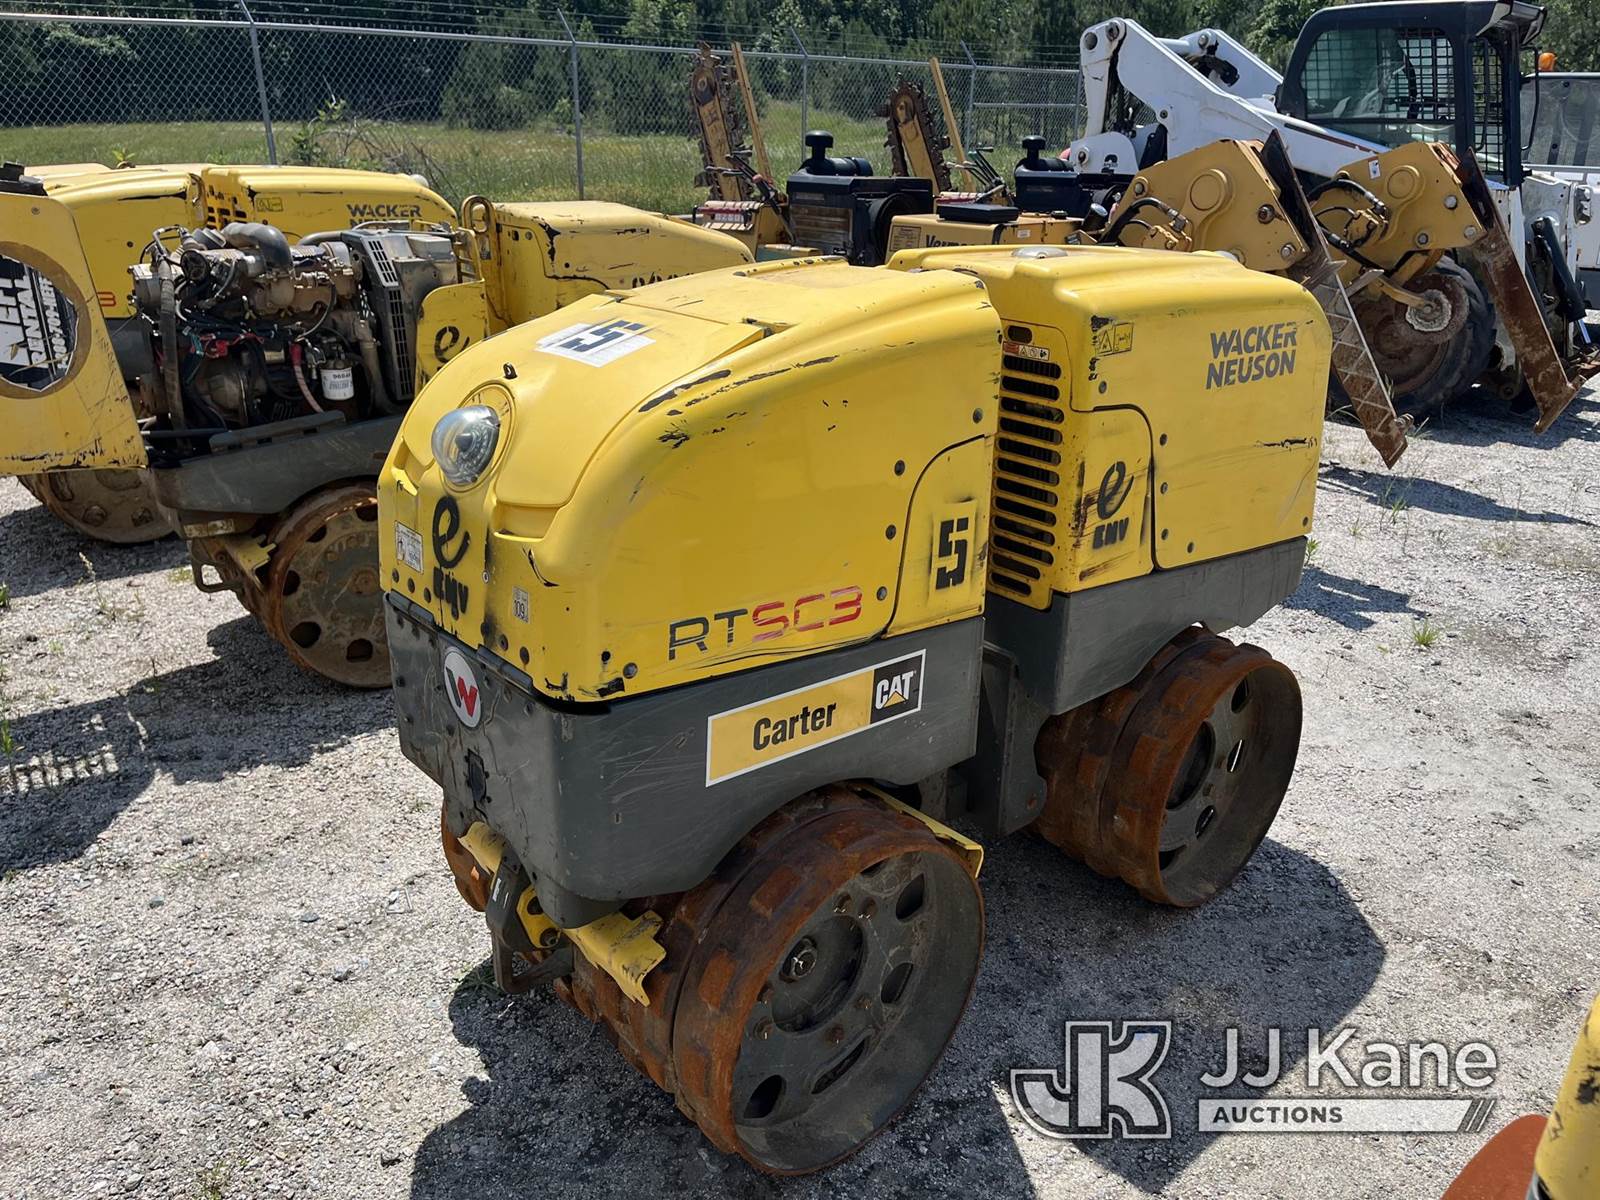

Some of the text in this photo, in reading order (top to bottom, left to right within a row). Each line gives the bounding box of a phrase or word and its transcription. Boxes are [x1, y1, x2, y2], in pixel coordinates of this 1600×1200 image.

[346, 203, 422, 218] WACKER
[13, 275, 49, 369] RENTAL
[559, 319, 647, 353] 5
[1209, 321, 1298, 360] WACKER
[1206, 349, 1297, 390] NEUSON
[935, 516, 969, 590] 5
[875, 671, 914, 710] CAT
[752, 701, 837, 751] Carter
